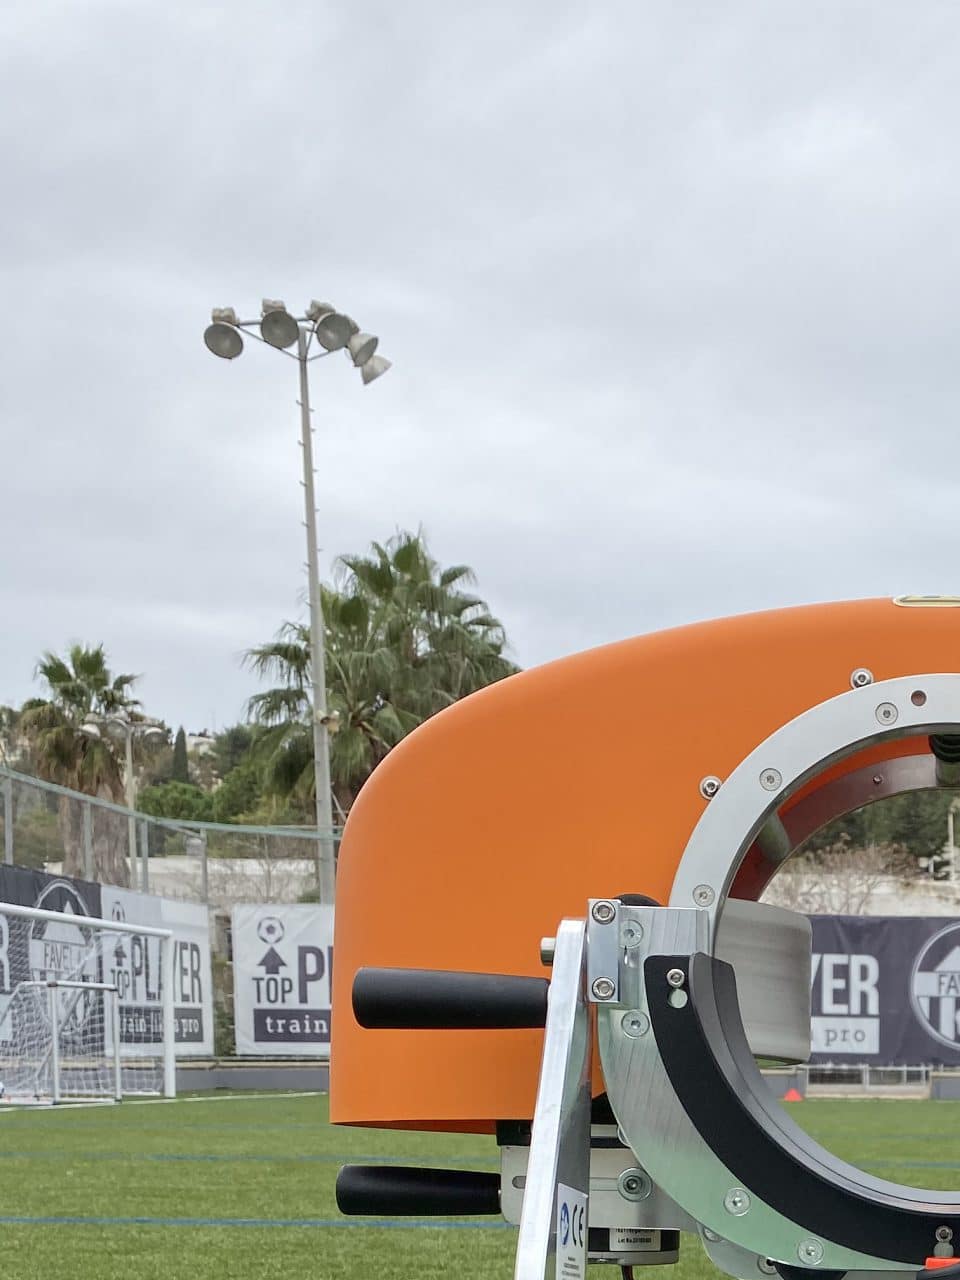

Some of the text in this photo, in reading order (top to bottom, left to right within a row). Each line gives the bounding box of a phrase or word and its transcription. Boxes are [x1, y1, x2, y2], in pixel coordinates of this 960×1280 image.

[252, 976, 293, 1004] TOP
[181, 1018, 201, 1038] pro
[265, 1014, 329, 1034] train
[824, 1029, 866, 1047] pro
